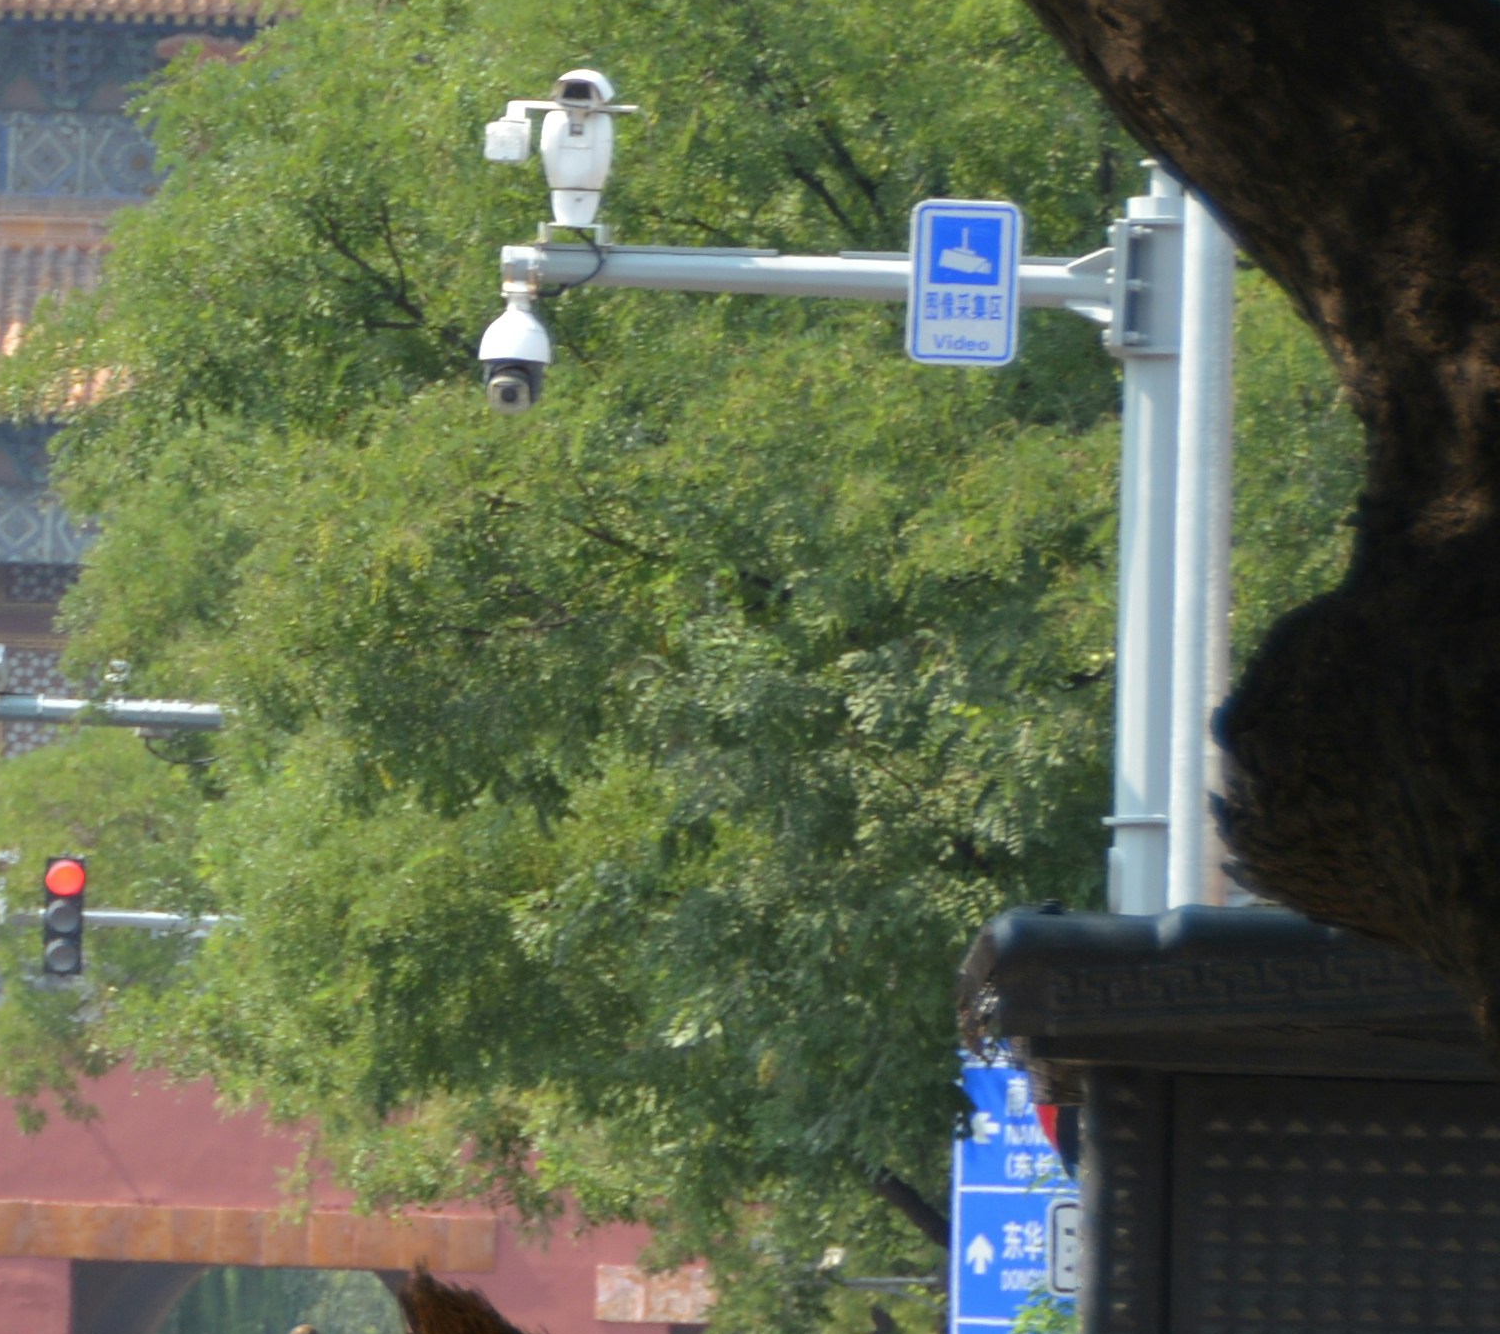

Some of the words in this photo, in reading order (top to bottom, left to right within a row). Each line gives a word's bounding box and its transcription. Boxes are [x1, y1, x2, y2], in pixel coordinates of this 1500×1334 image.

[925, 292, 1002, 320] 图像采集区
[933, 334, 989, 351] Video
[1002, 1221, 1044, 1260] 东华
